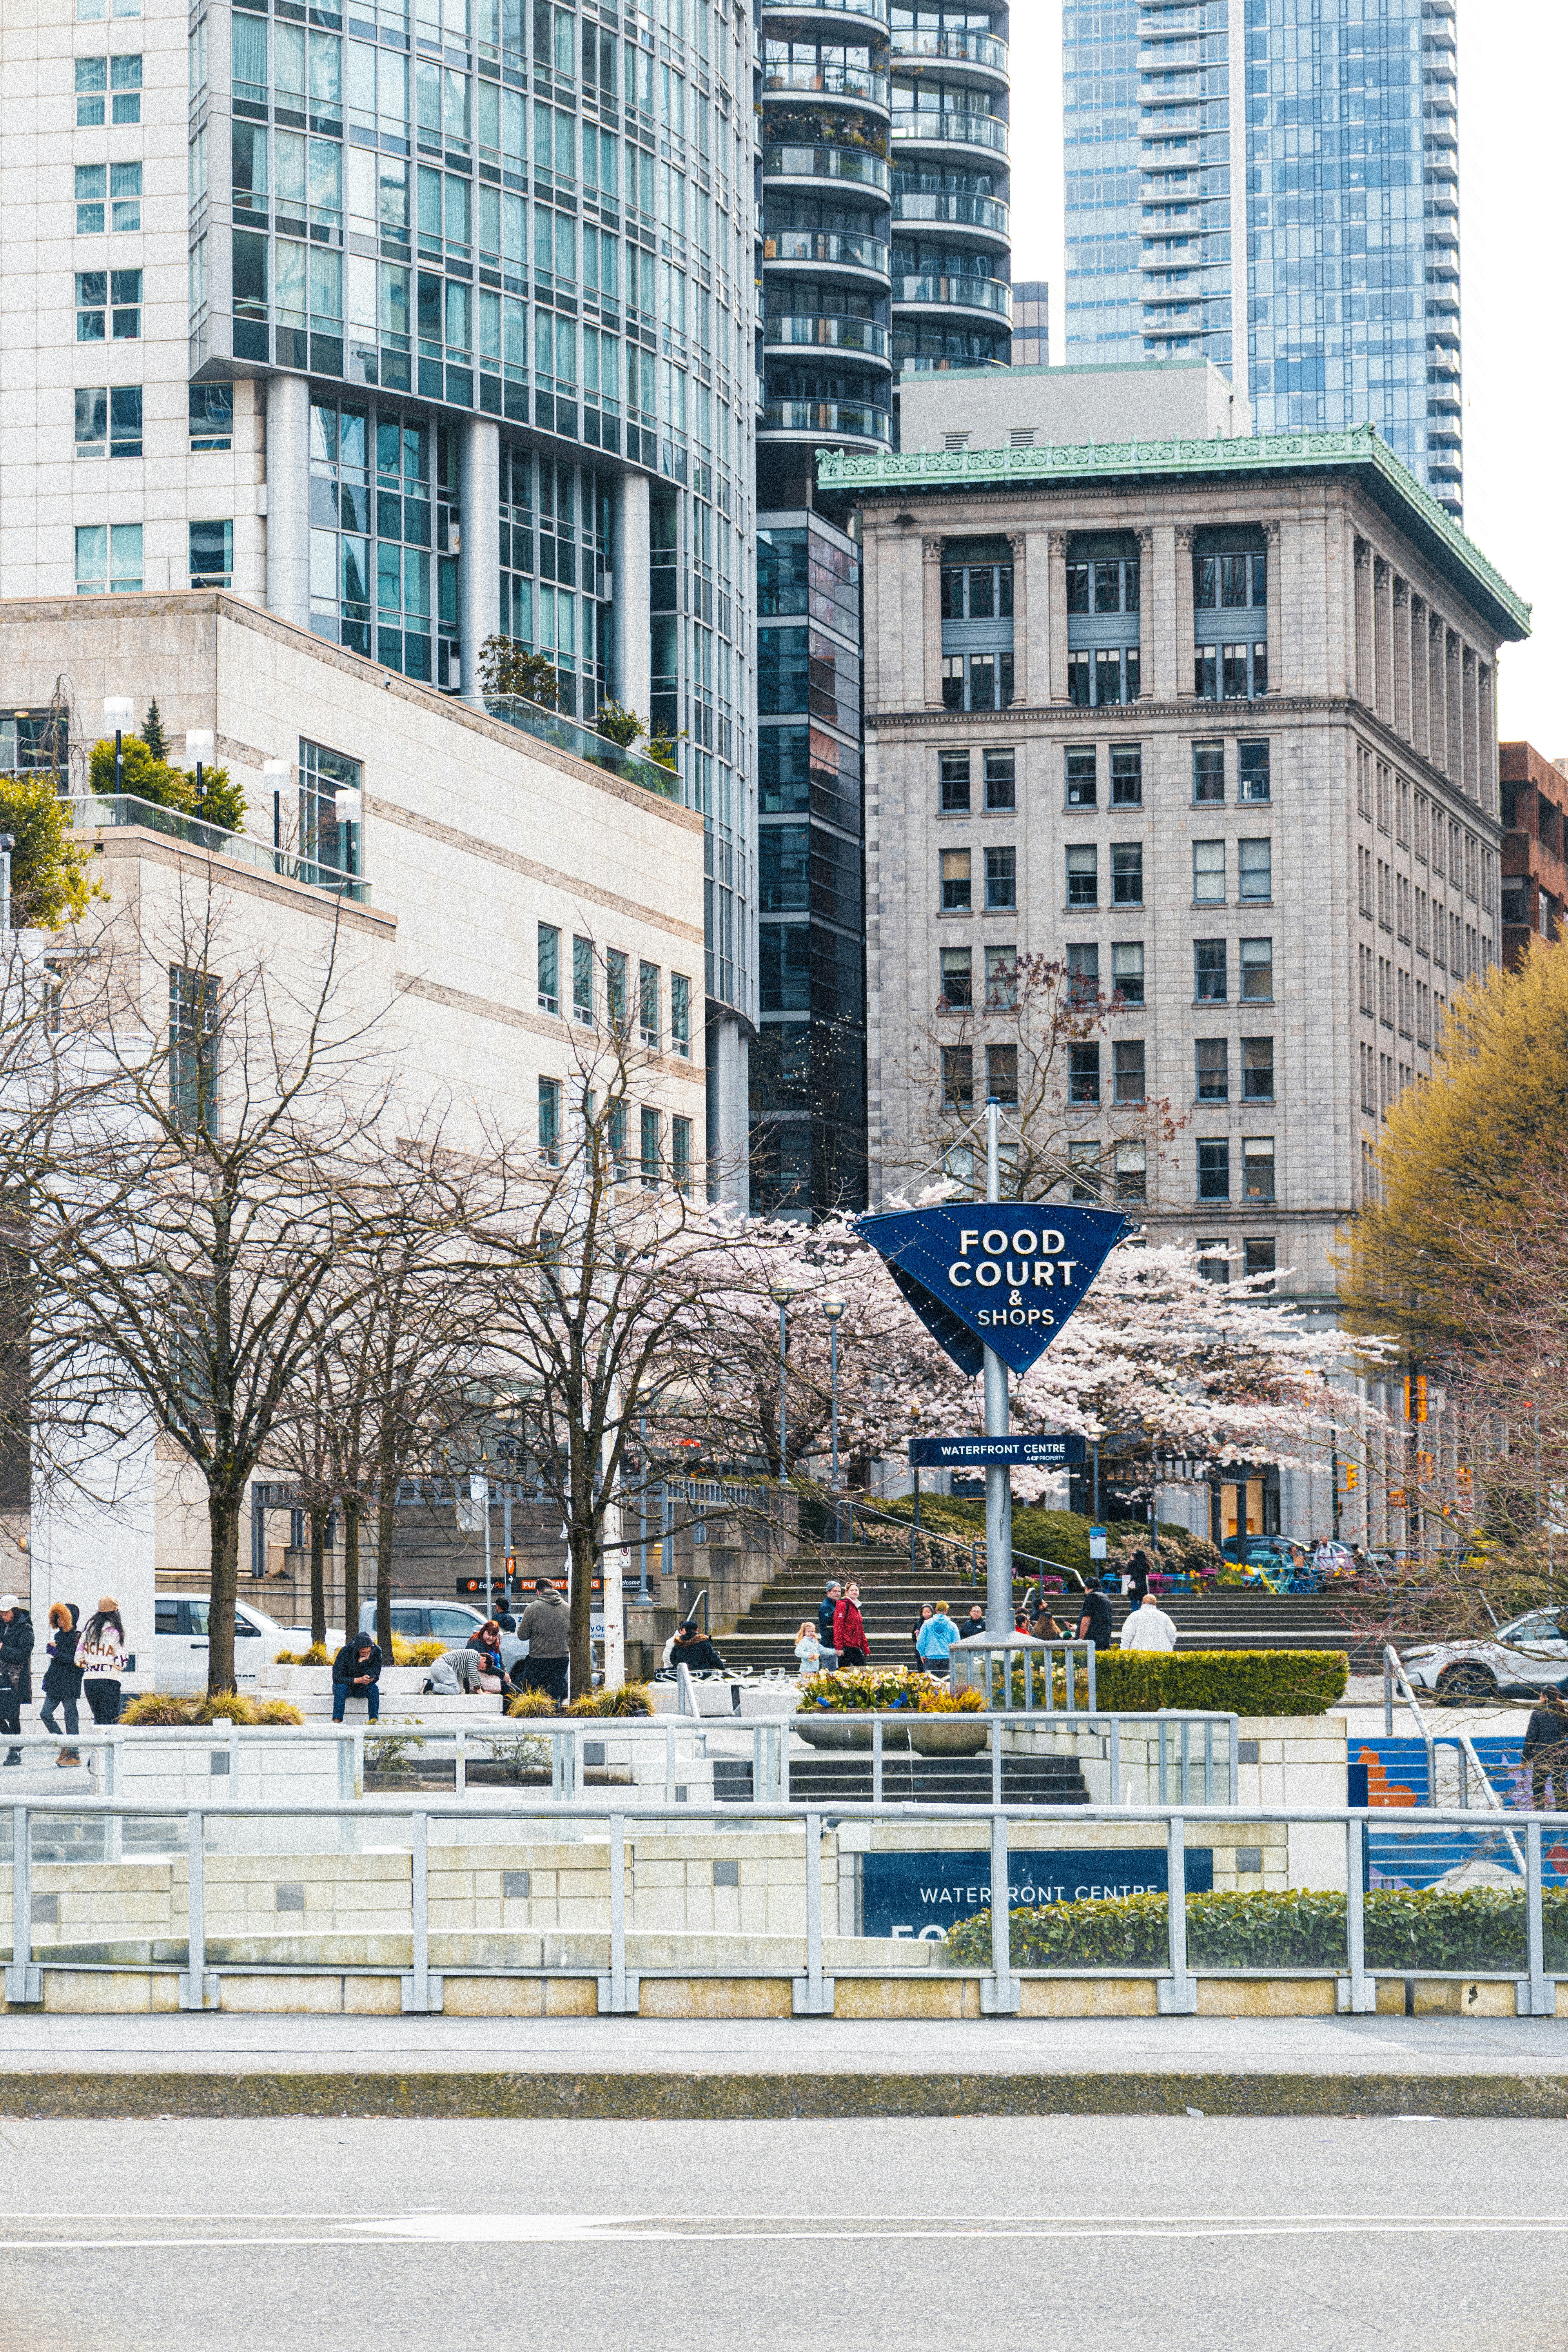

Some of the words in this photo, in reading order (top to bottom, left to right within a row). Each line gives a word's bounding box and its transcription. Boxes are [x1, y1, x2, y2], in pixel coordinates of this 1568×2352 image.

[960, 1229, 1065, 1254] FOOD
[949, 1260, 1077, 1287] COURT
[1009, 1289, 1022, 1306] &
[978, 1309, 1054, 1325] SHOPS
[941, 1445, 1019, 1455] WATERFRONT
[1024, 1444, 1065, 1453] CENTRE
[920, 1886, 1065, 1903] WATERRONT
